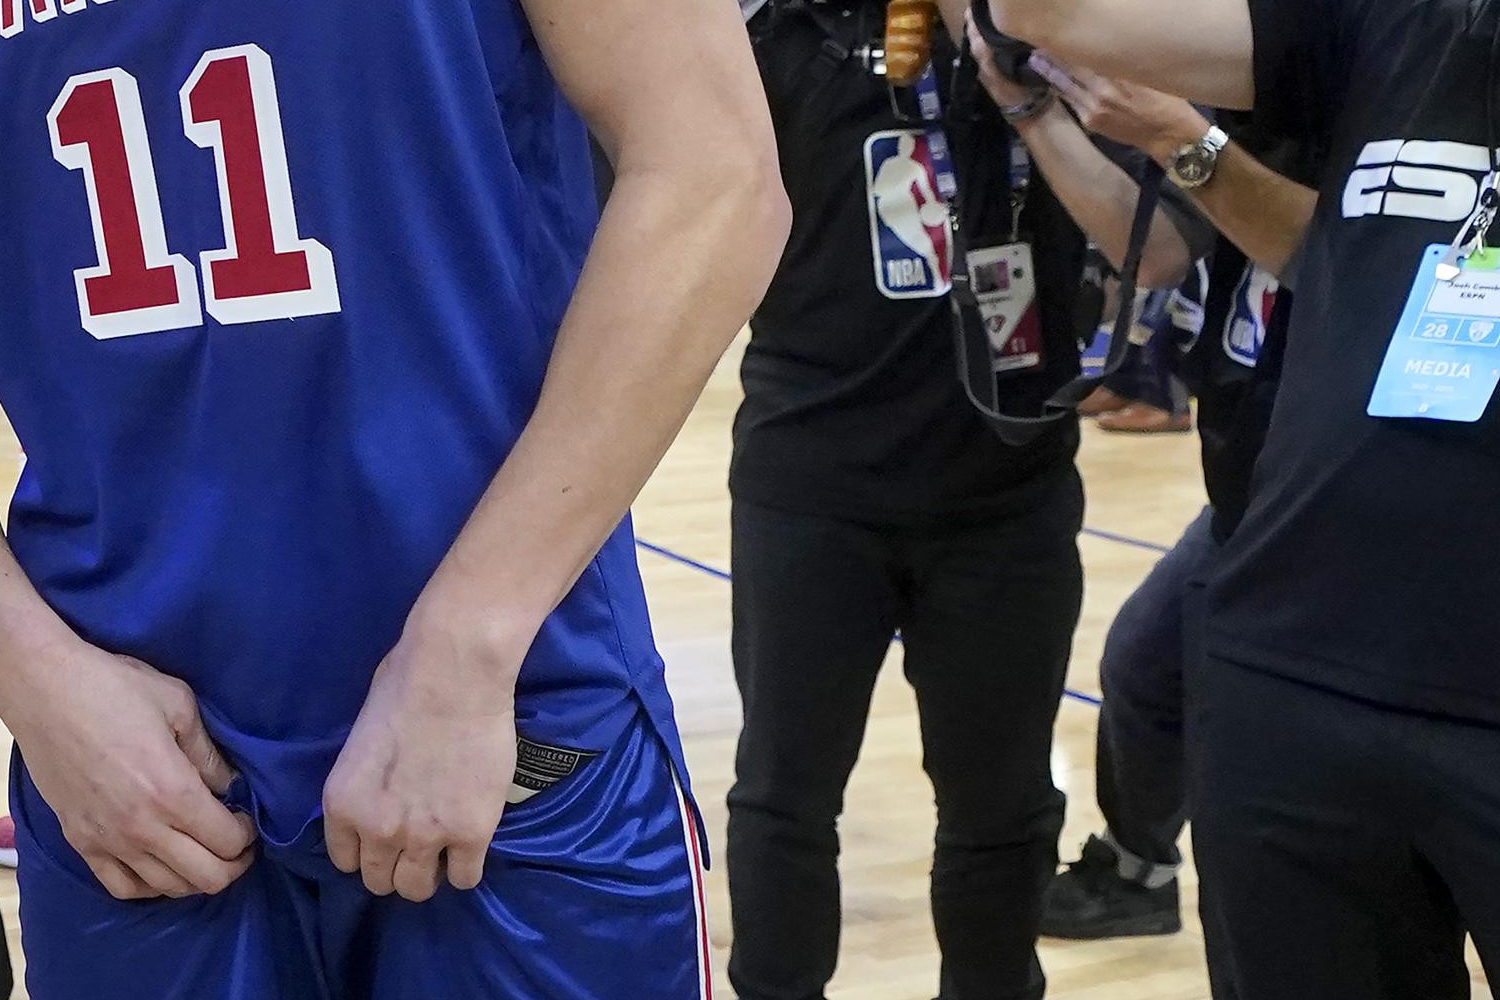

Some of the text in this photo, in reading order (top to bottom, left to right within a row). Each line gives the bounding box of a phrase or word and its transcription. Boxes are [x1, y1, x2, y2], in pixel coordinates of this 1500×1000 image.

[46, 43, 341, 340] 11
[1342, 139, 1500, 222] ES
[887, 257, 927, 288] NBA
[1421, 322, 1449, 338] 28
[1404, 359, 1472, 379] MEDIA
